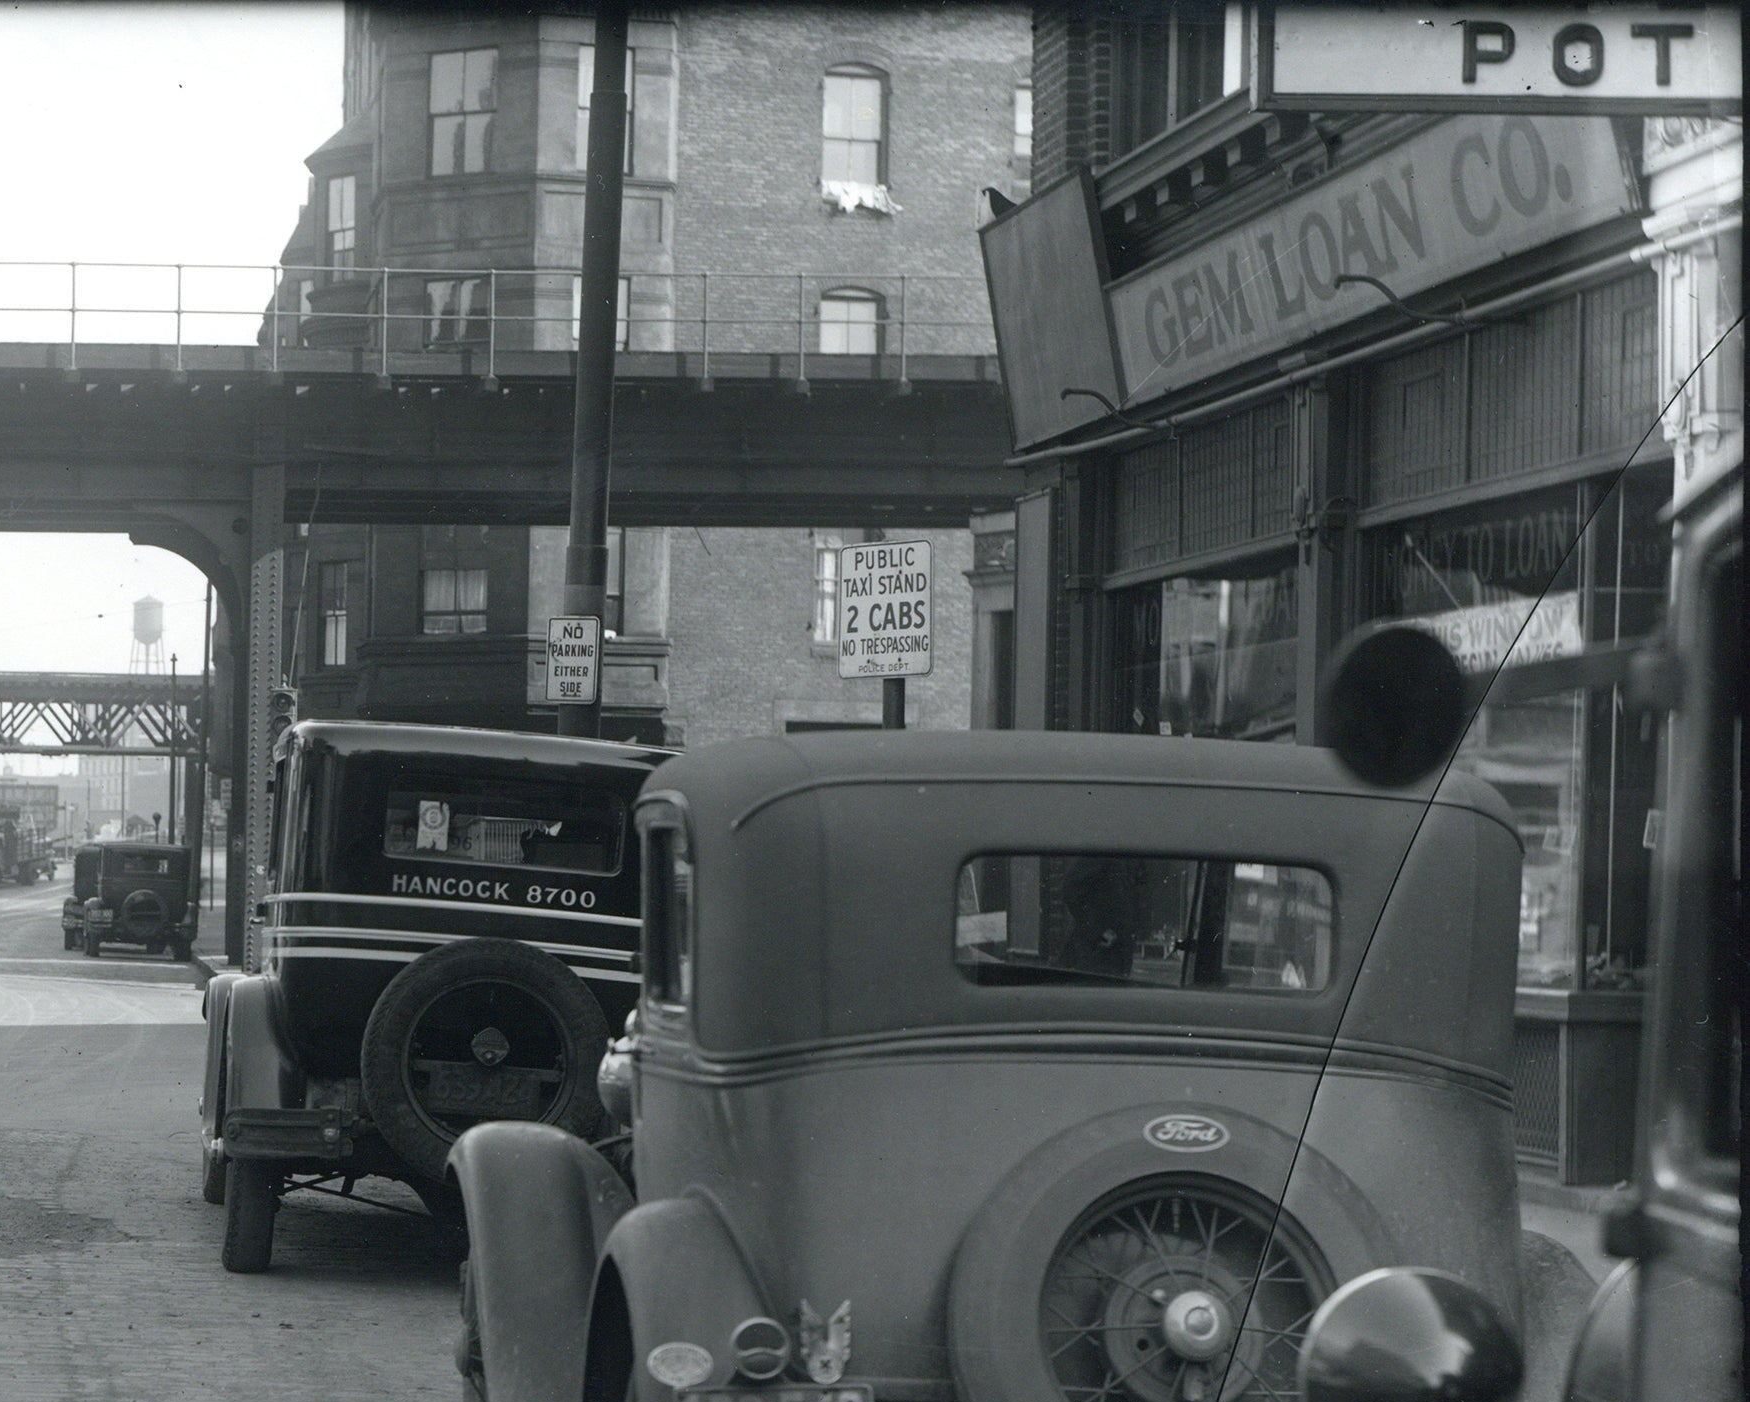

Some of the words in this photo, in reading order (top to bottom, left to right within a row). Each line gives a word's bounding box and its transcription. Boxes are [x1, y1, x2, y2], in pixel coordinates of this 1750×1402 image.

[1461, 20, 1695, 87] POT
[1144, 249, 1255, 370] GEM
[1259, 164, 1427, 320] LOAN
[1450, 115, 1574, 237] CO.
[1461, 521, 1494, 583] TO
[1504, 507, 1569, 579] LOAN
[854, 547, 915, 571] PUBLIC
[843, 574, 873, 598] TAXI
[878, 573, 927, 595] STAND
[846, 605, 859, 634] 2
[868, 600, 926, 632] CABS
[562, 625, 584, 639] NO
[551, 643, 594, 658] PARKING
[842, 639, 856, 657] NO
[860, 635, 930, 655] TRESPASSING
[554, 665, 589, 678] EITHER
[858, 663, 885, 674] POLICE
[559, 681, 583, 693] SIDE
[391, 874, 511, 900] HANCOCK
[525, 885, 597, 909] 8700
[1155, 1120, 1220, 1142] Ford
